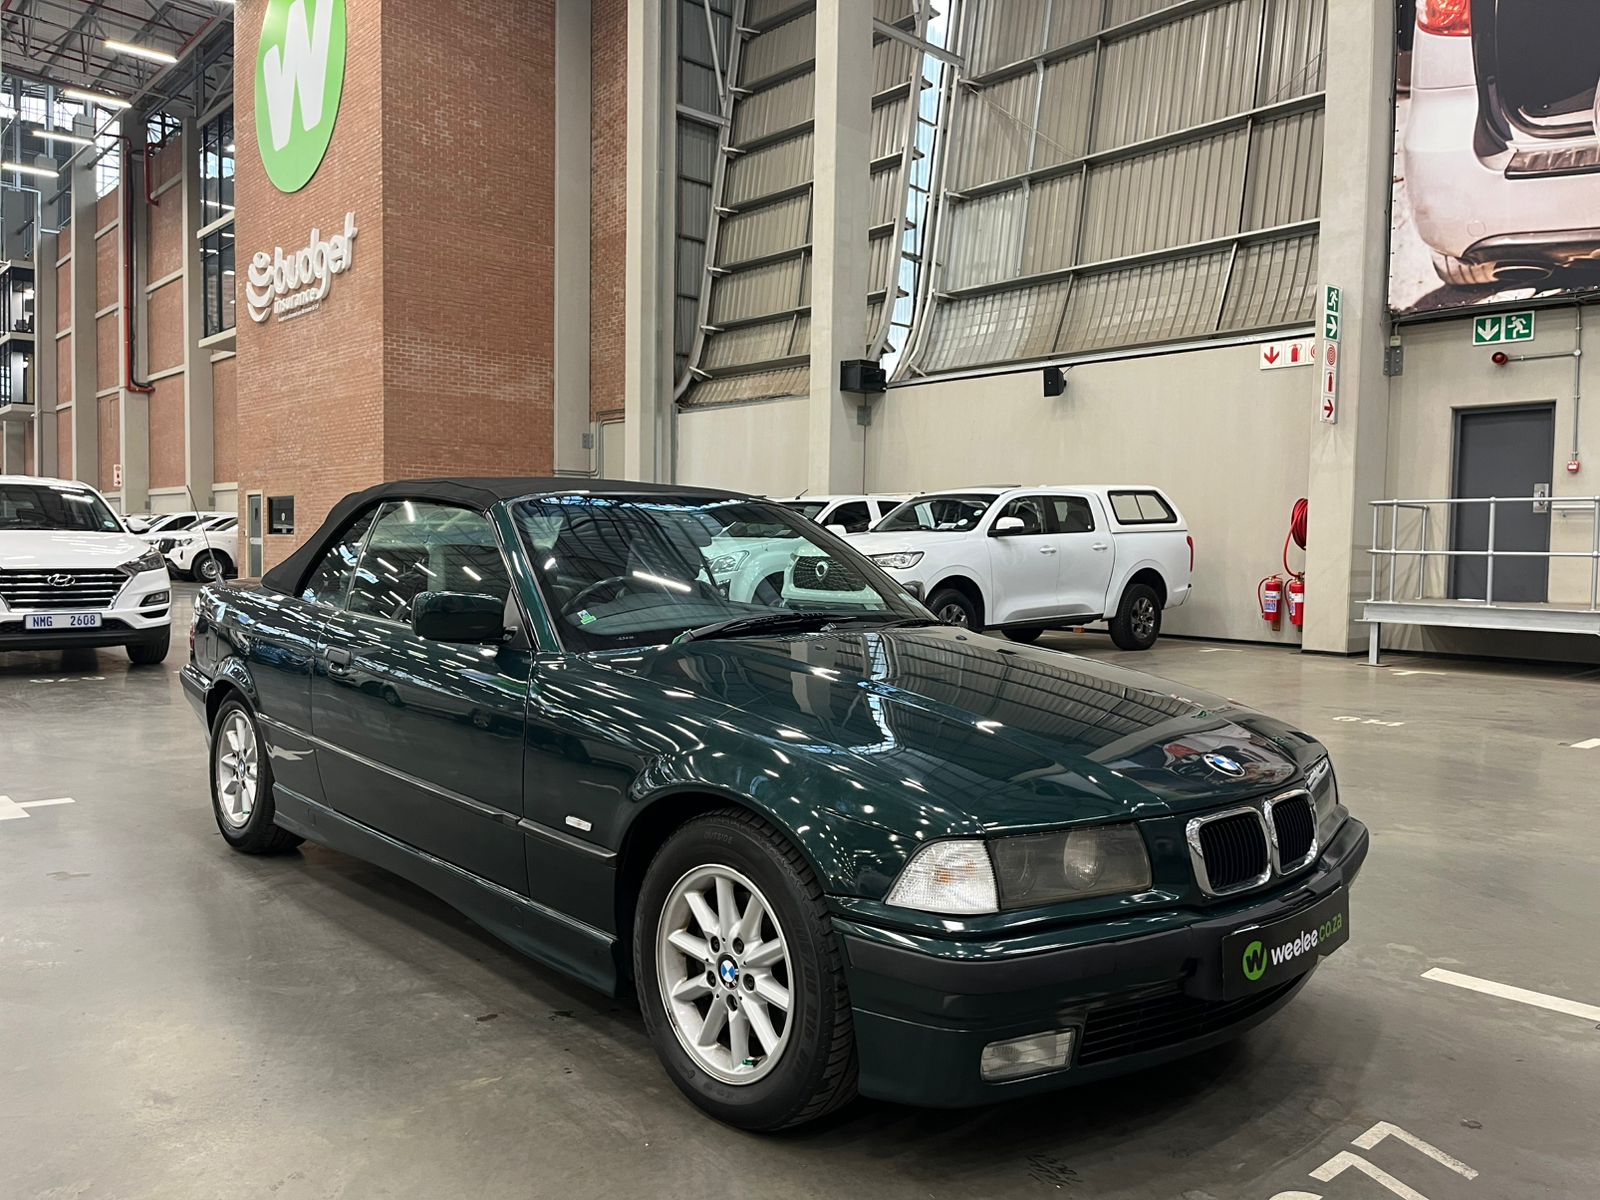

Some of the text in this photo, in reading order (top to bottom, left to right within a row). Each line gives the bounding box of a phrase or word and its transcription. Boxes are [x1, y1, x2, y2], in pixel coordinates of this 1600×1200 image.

[273, 211, 358, 301] budget
[32, 614, 96, 627] NMG 2608
[1271, 912, 1343, 966] weelee.co.za
